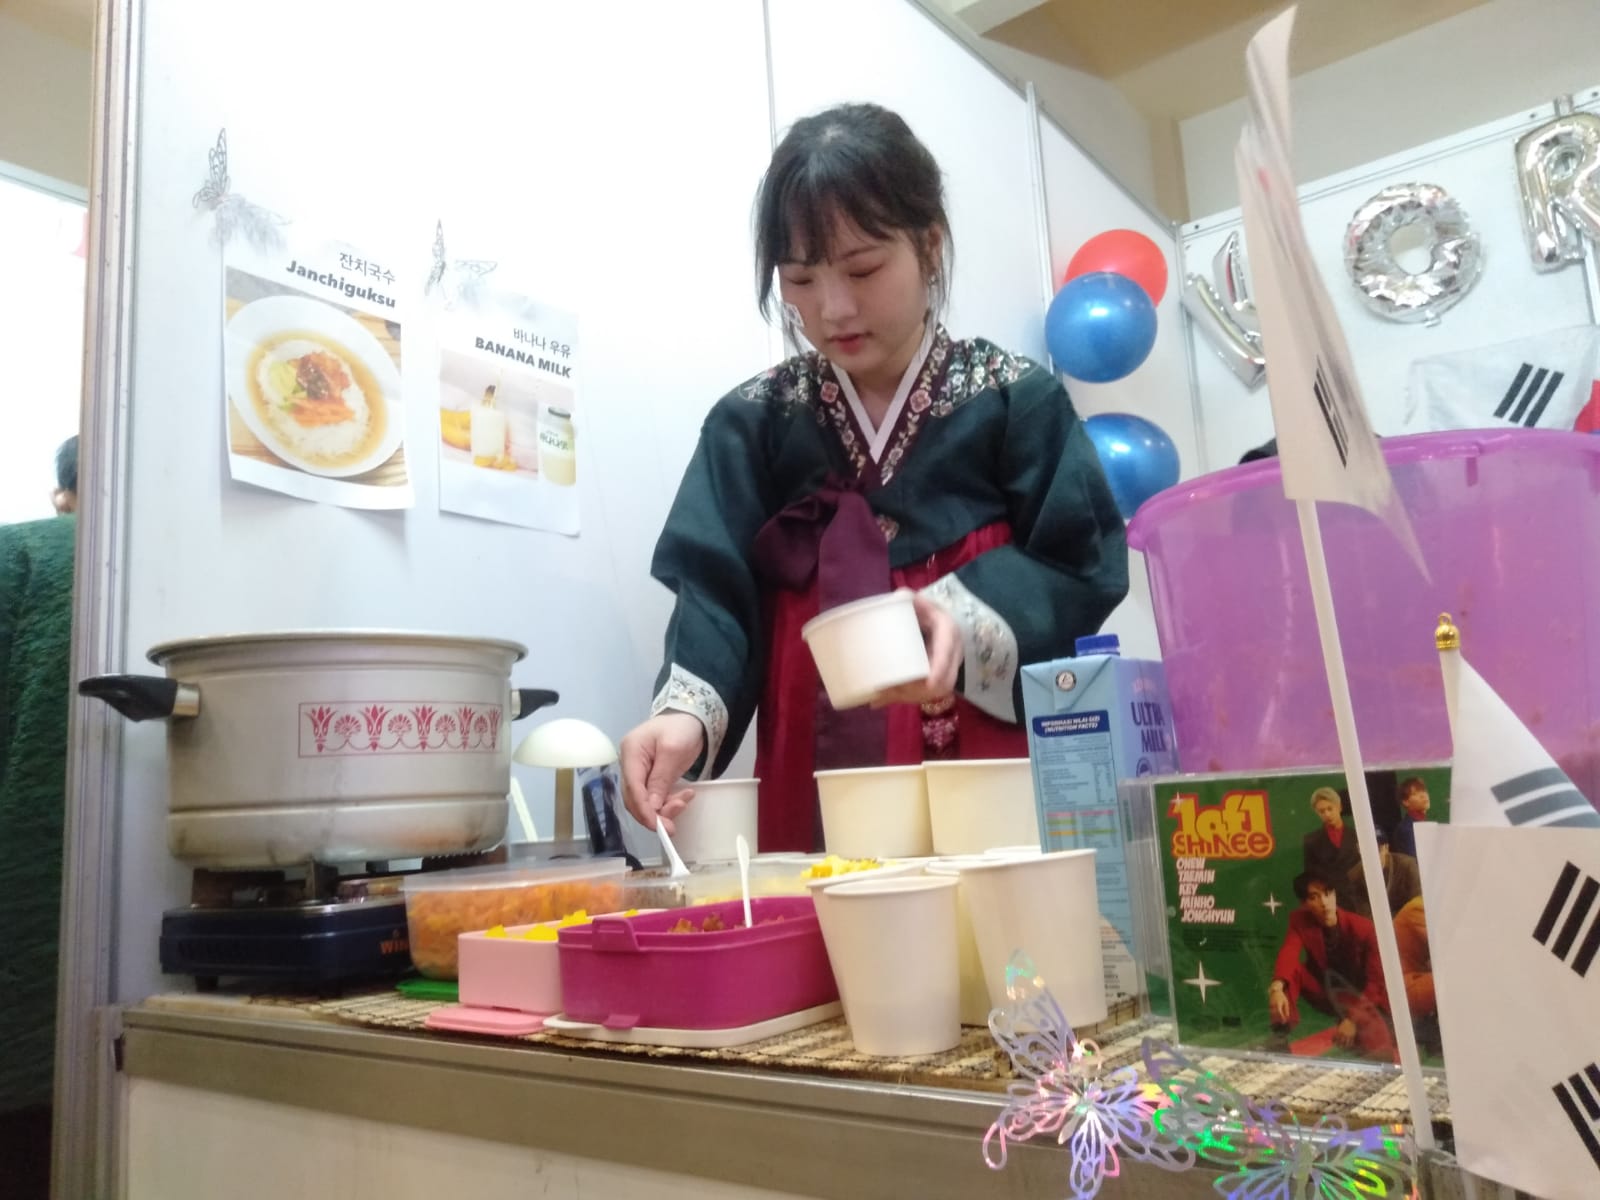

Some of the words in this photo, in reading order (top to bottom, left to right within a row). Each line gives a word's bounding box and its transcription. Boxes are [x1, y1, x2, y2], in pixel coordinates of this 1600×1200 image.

[339, 252, 396, 285] 잔치국수
[286, 260, 396, 308] Janchiguksu
[513, 328, 546, 351] 바나나
[550, 340, 571, 359] 우유
[475, 336, 535, 367] BANANA
[538, 358, 572, 379] MILK
[1178, 869, 1215, 884] TAEMIN
[1178, 883, 1199, 897] KEY
[1180, 895, 1215, 910] MINHO
[1181, 908, 1236, 924] JONGHYUN
